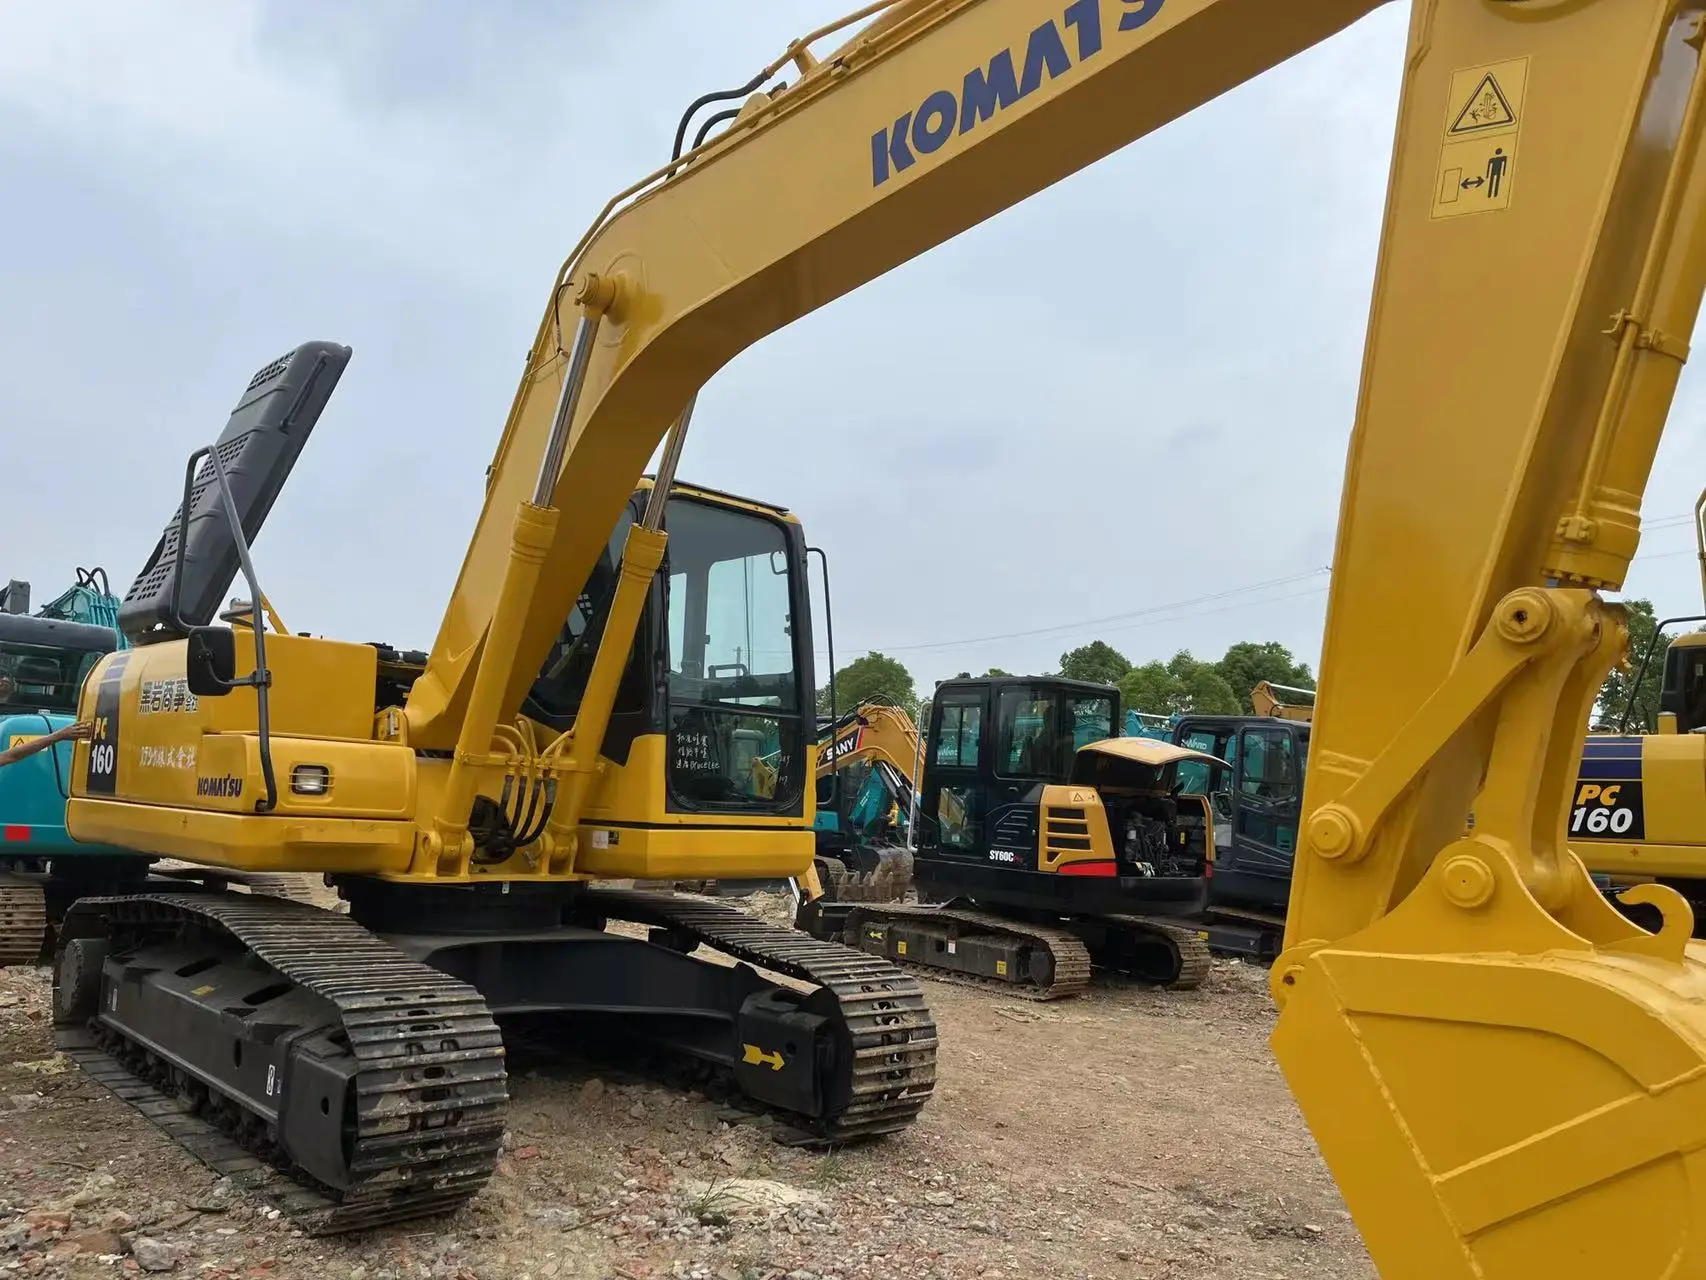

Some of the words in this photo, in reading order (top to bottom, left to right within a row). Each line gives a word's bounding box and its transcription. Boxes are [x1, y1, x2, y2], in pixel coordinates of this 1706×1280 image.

[94, 717, 108, 740] PC
[91, 744, 114, 775] 160
[826, 737, 854, 761] SANY
[196, 773, 243, 798] KOMATSU
[1576, 784, 1621, 806] PC
[1571, 807, 1634, 833] 160
[989, 849, 1014, 862] SY60C
